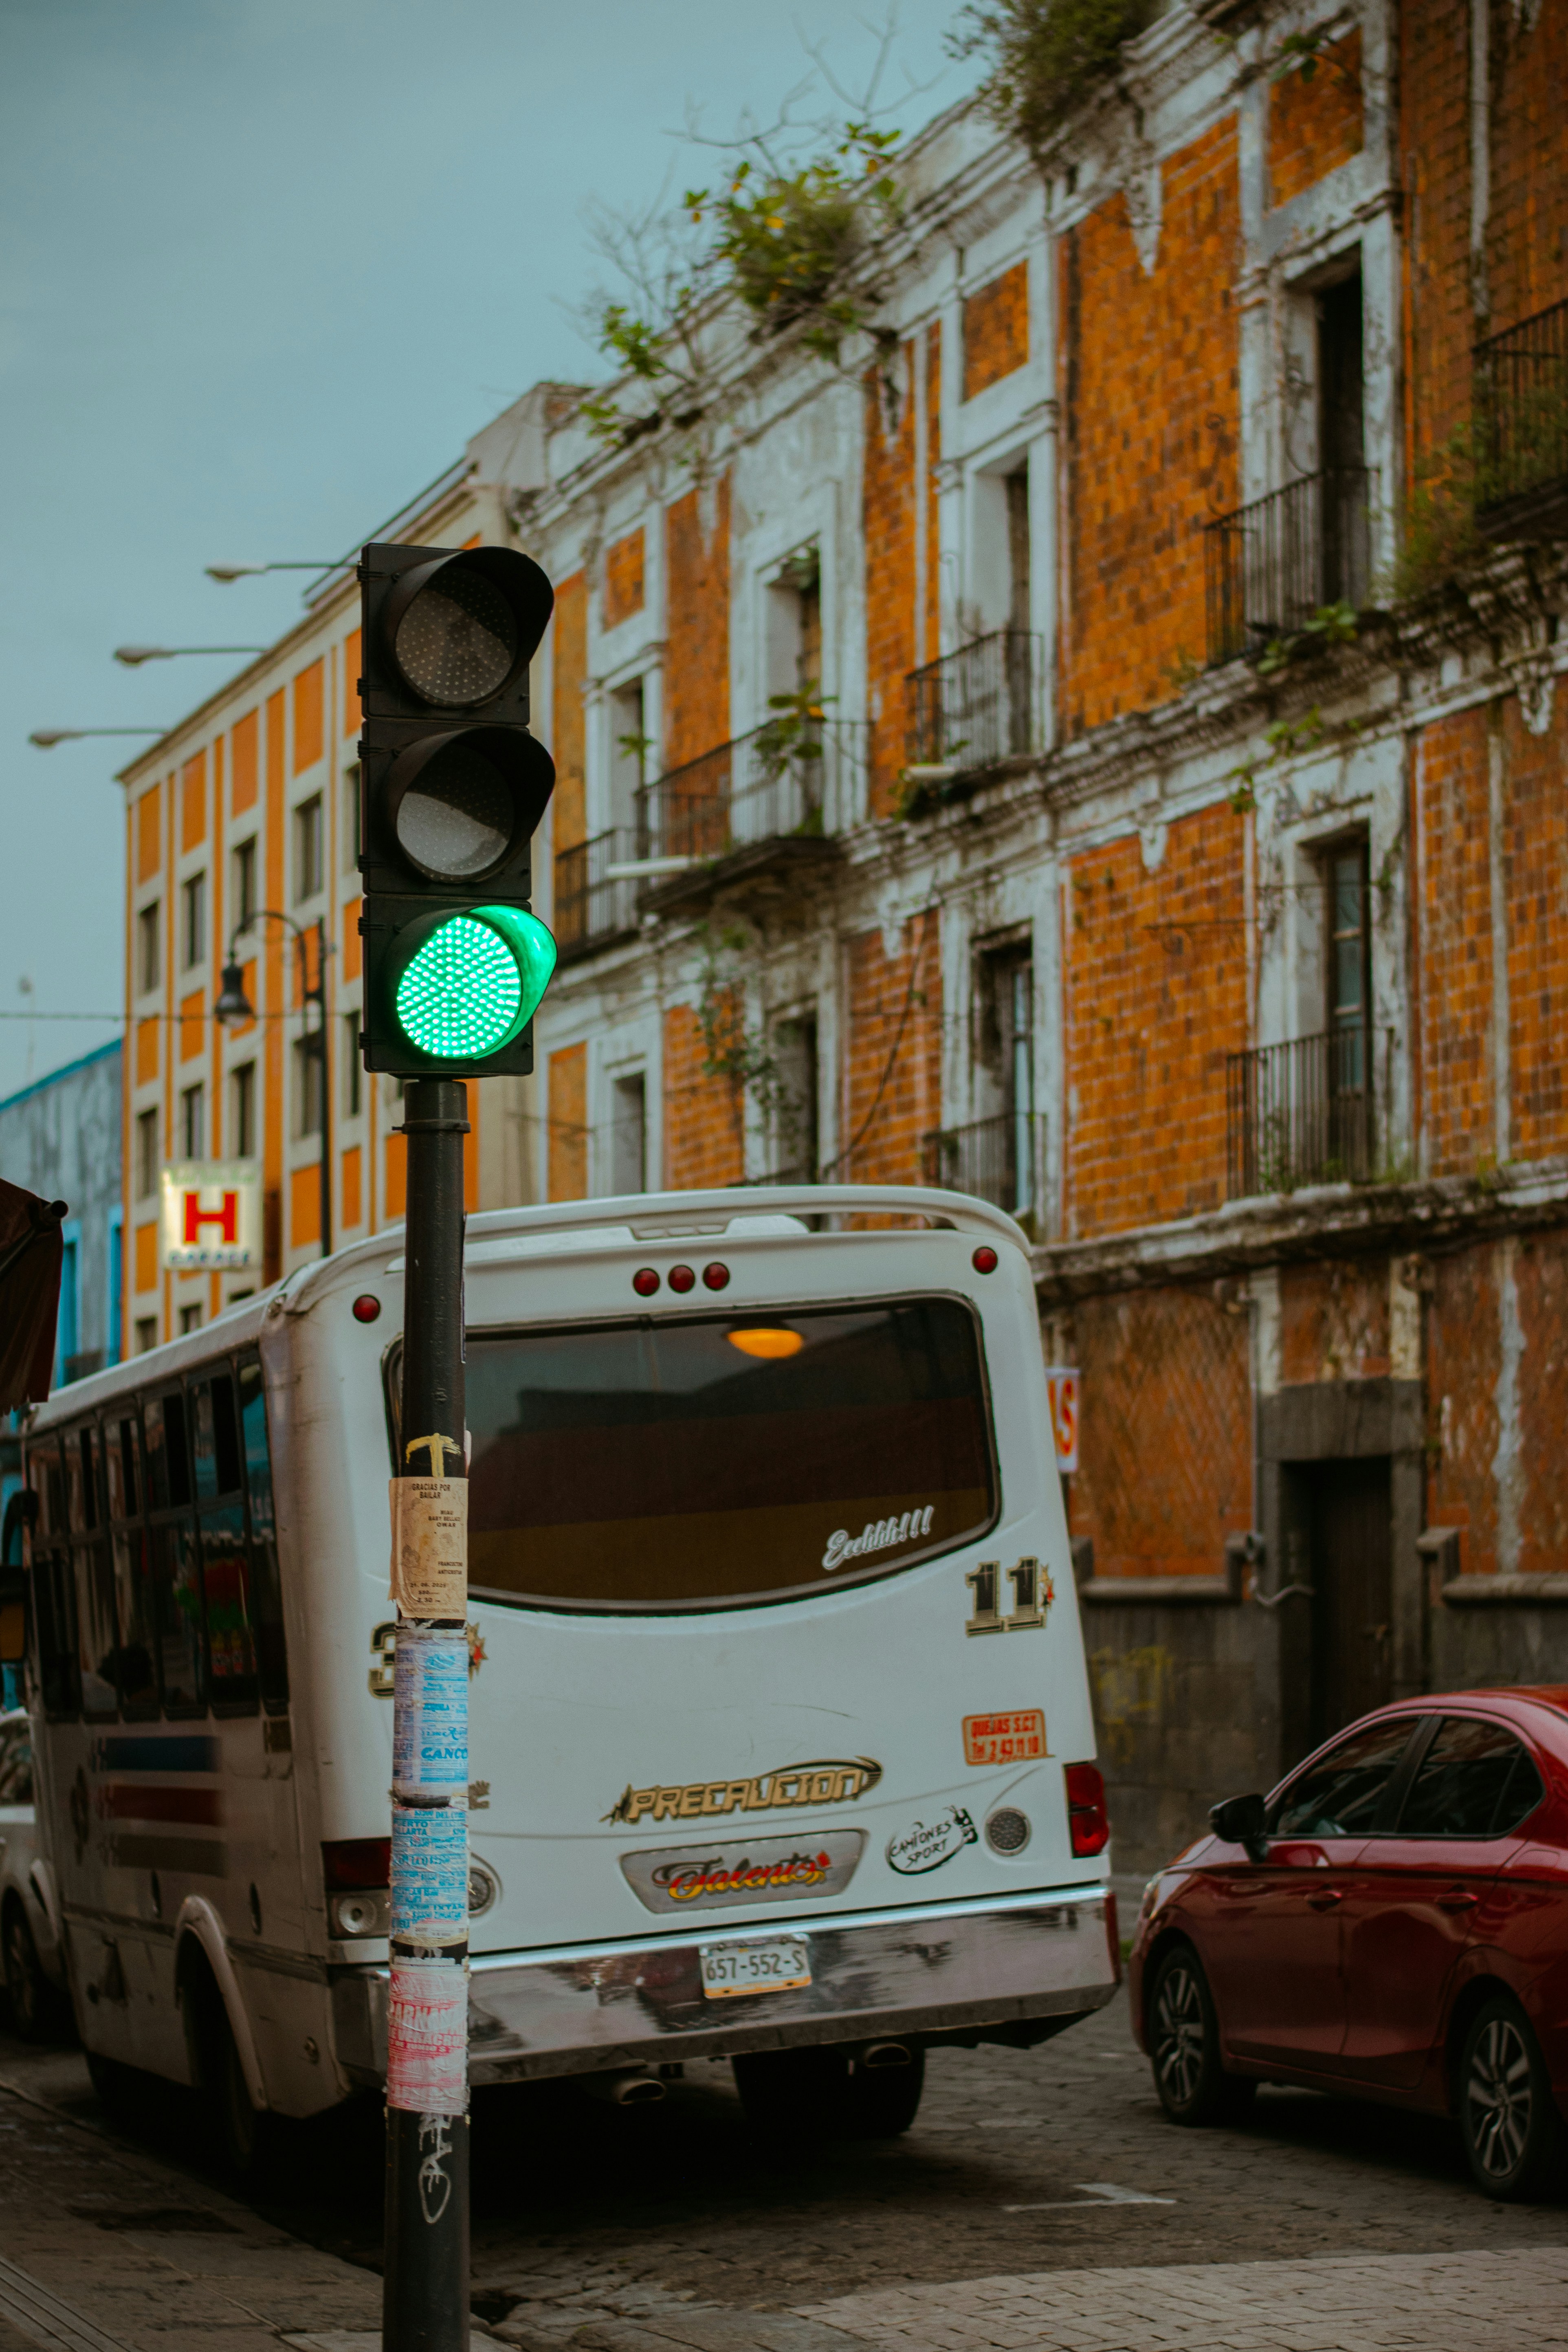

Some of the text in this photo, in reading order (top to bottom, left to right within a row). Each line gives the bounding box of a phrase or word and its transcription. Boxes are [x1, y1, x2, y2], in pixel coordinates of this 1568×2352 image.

[180, 1190, 237, 1243] H
[965, 1556, 1045, 1637] 11
[972, 1718, 1010, 1740] QUEJAS
[625, 1768, 864, 1824] PRECAUCION
[706, 1949, 805, 1981] 657-552-S
